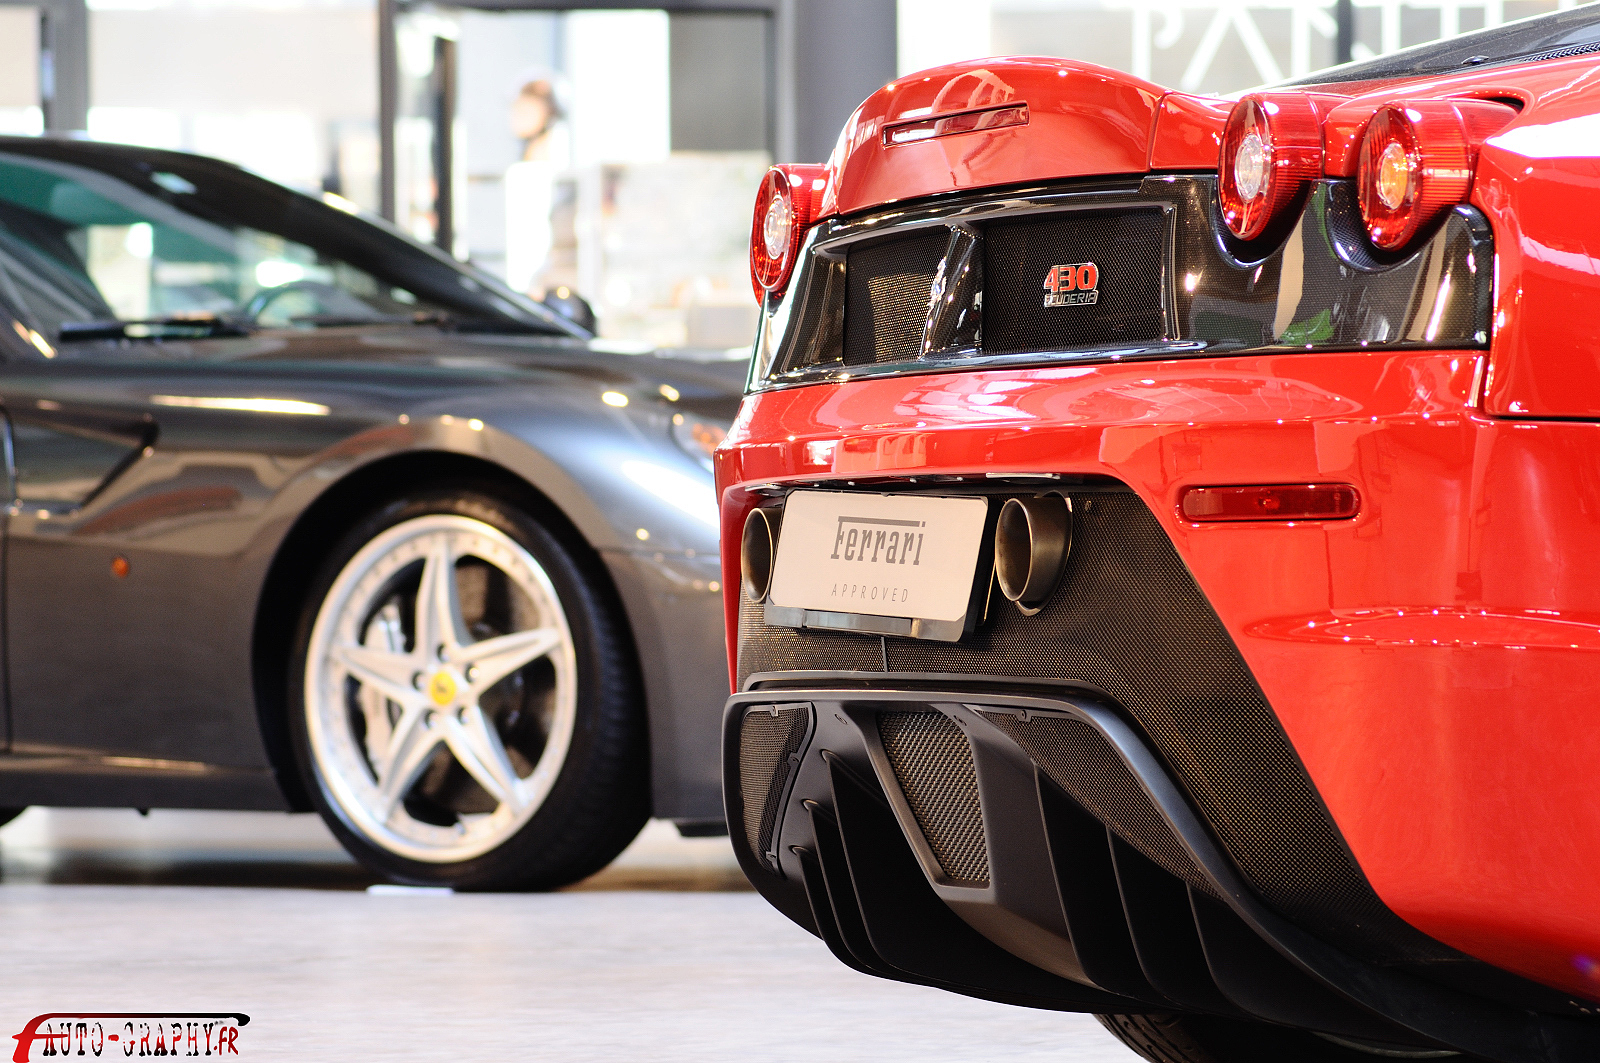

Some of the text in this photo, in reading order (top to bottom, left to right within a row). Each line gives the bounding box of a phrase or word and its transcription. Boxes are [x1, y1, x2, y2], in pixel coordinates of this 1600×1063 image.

[1044, 264, 1098, 292] 430
[830, 515, 926, 566] Ferrari
[831, 583, 909, 602] APPROVED
